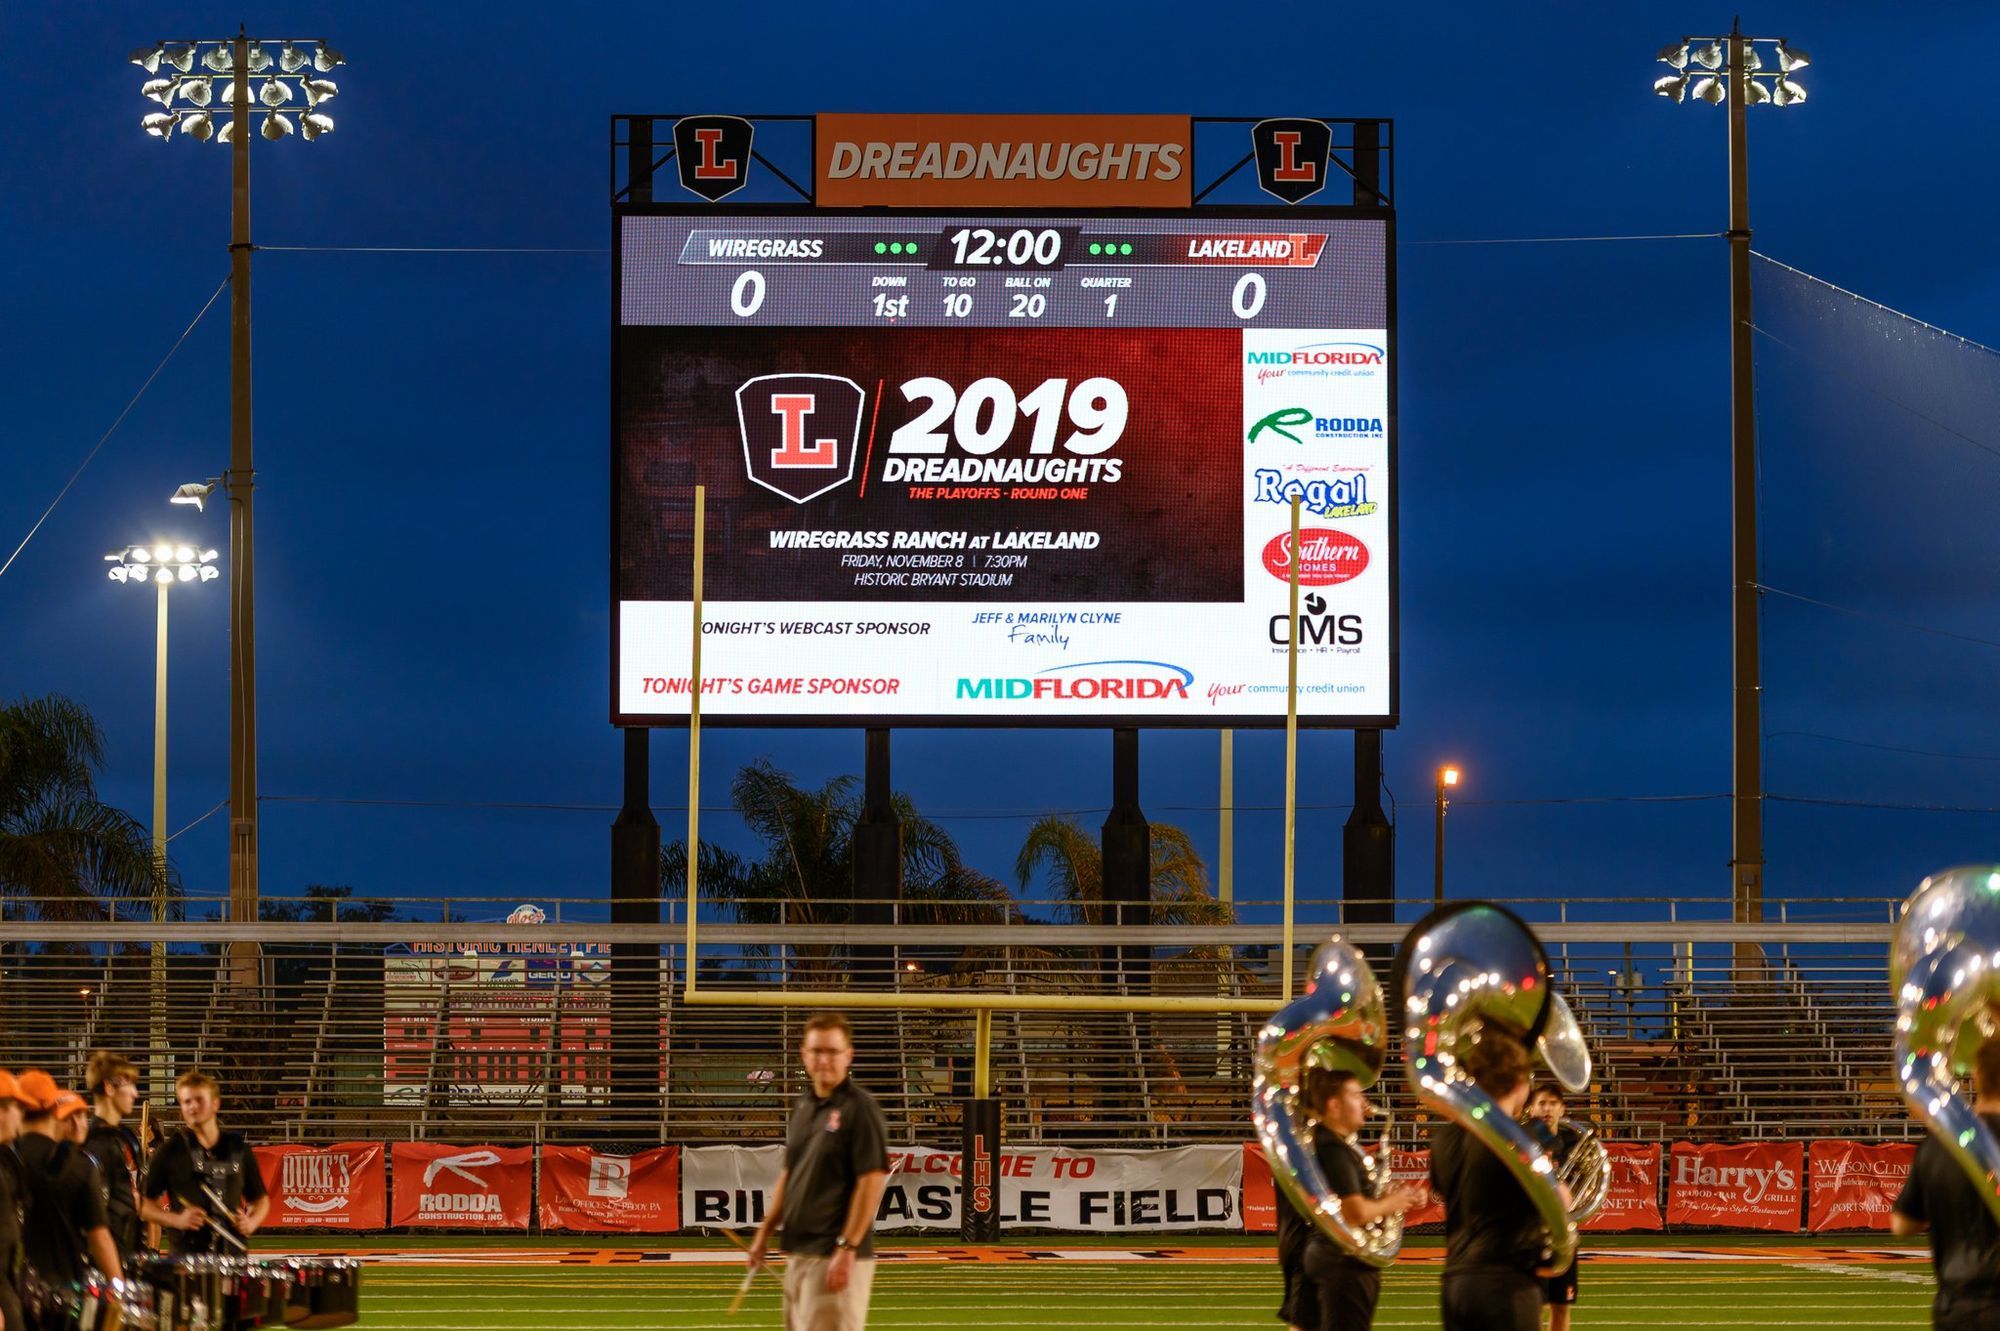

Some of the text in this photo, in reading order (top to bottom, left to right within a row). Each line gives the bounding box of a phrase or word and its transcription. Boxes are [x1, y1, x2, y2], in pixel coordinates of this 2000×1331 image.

[695, 129, 737, 179] L
[828, 141, 1184, 181] DREADNAUGHTS
[1274, 131, 1316, 182] L
[708, 239, 823, 257] WIREGRASS
[950, 229, 1062, 265] 12:00
[1188, 239, 1292, 258] LAKELAND
[872, 276, 907, 287] DOWN
[943, 276, 976, 287] TO GO
[1005, 277, 1051, 288] BALL ON
[1081, 277, 1132, 289] QUARTER
[731, 270, 766, 317] 0
[1232, 272, 1267, 319] 0
[872, 293, 909, 317] 1st
[942, 293, 973, 317] 10
[1009, 293, 1047, 318] 20
[1104, 294, 1117, 318] 1
[1247, 352, 1382, 364] MIDFLORIDA
[1258, 368, 1287, 386] Your
[1288, 369, 1329, 378] community
[888, 376, 1129, 455] 2019
[1315, 418, 1383, 432] RODDA
[771, 394, 838, 468] L
[883, 458, 1123, 484] DREADNAUGHTS
[909, 488, 933, 499] THE
[935, 488, 1001, 499] PLAYOFFS
[1010, 488, 1058, 499] ROUND
[1060, 488, 1088, 499] ONE
[1254, 468, 1368, 515] Regal
[1324, 502, 1378, 519] LAKELAND
[769, 531, 1100, 550] WIREGRASS RANCH AT LAKELAND
[841, 555, 1028, 569] FRIDAY, NOVEMBER 8 7:30PM
[855, 572, 1013, 587] HISTORIC BRYANT STADIUM
[701, 622, 931, 635] ONIGHT'S WEBCAST SPONSOR
[972, 613, 1122, 624] JEFF & MARILYN CLYNE
[1008, 625, 1070, 650] Family
[747, 678, 803, 695] GAME
[807, 678, 900, 695] SPONSOR
[956, 678, 1189, 700] MIDFLORIDA
[1207, 683, 1246, 707] Your
[1306, 683, 1335, 693] credit
[1336, 684, 1366, 693] union
[282, 1154, 350, 1188] DUKE'S
[1051, 1156, 1096, 1179] TO
[1391, 1154, 1430, 1169] HAN
[1873, 1161, 1913, 1176] CLINI
[973, 1134, 991, 1212] LHS
[1674, 1155, 1796, 1204] Harry's
[420, 1193, 502, 1212] RODDA
[694, 1189, 767, 1223] BIL
[1079, 1188, 1233, 1226] FIELD
[1764, 1194, 1796, 1202] GRILLE
[1729, 1204, 1749, 1214] Style
